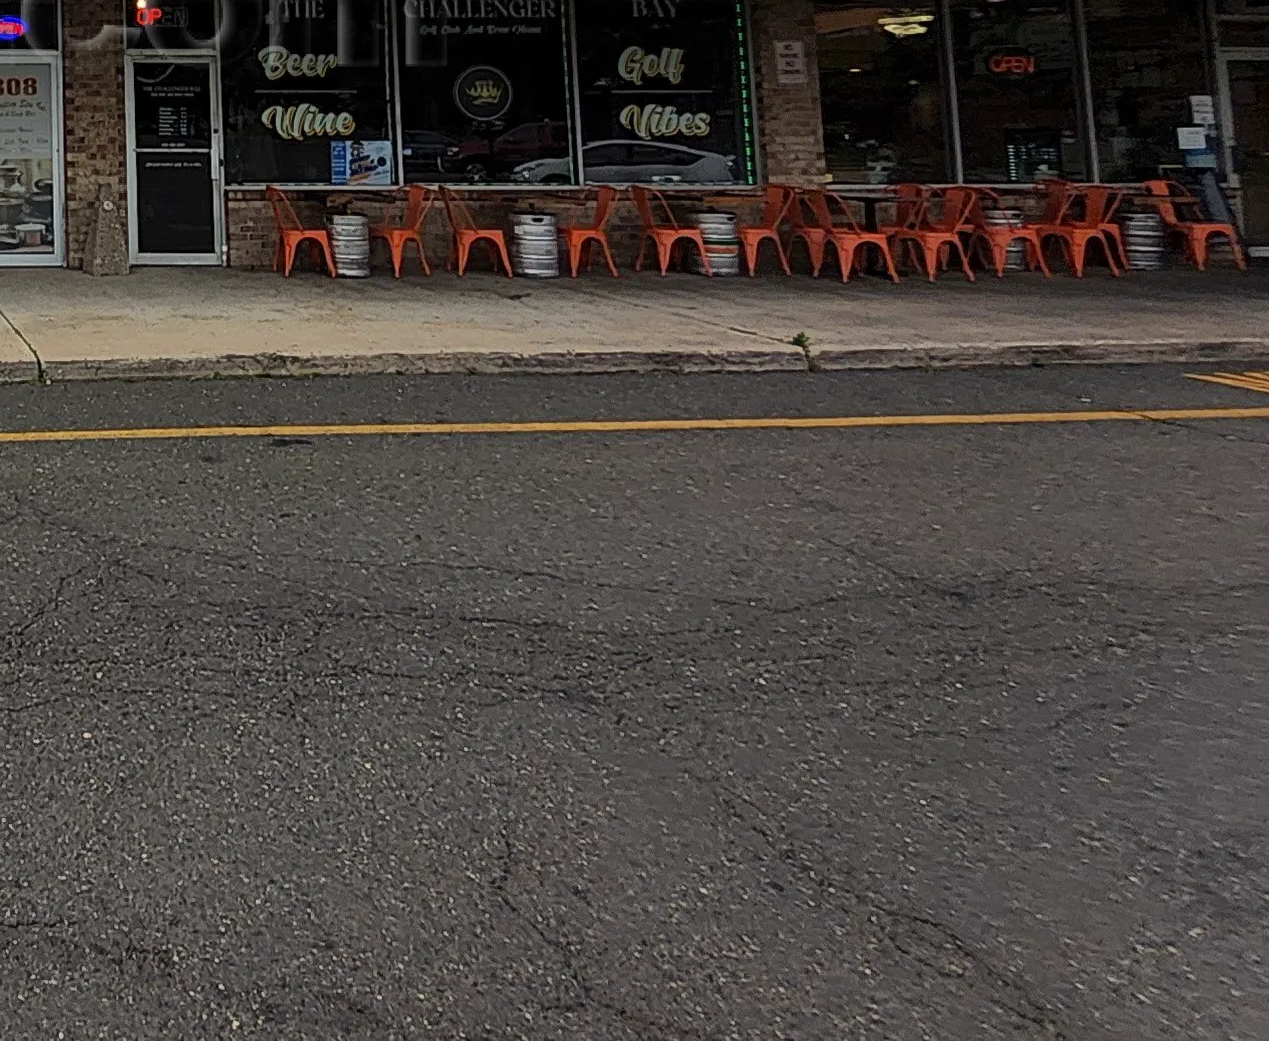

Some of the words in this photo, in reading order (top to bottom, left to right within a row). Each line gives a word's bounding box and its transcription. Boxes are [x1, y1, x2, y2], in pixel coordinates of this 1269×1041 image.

[135, 7, 186, 26] OPEN
[257, 44, 337, 81] Beer
[618, 45, 686, 87] Golf
[988, 55, 1035, 73] OPEN
[260, 102, 356, 142] Wine
[619, 103, 712, 141] Vibes
